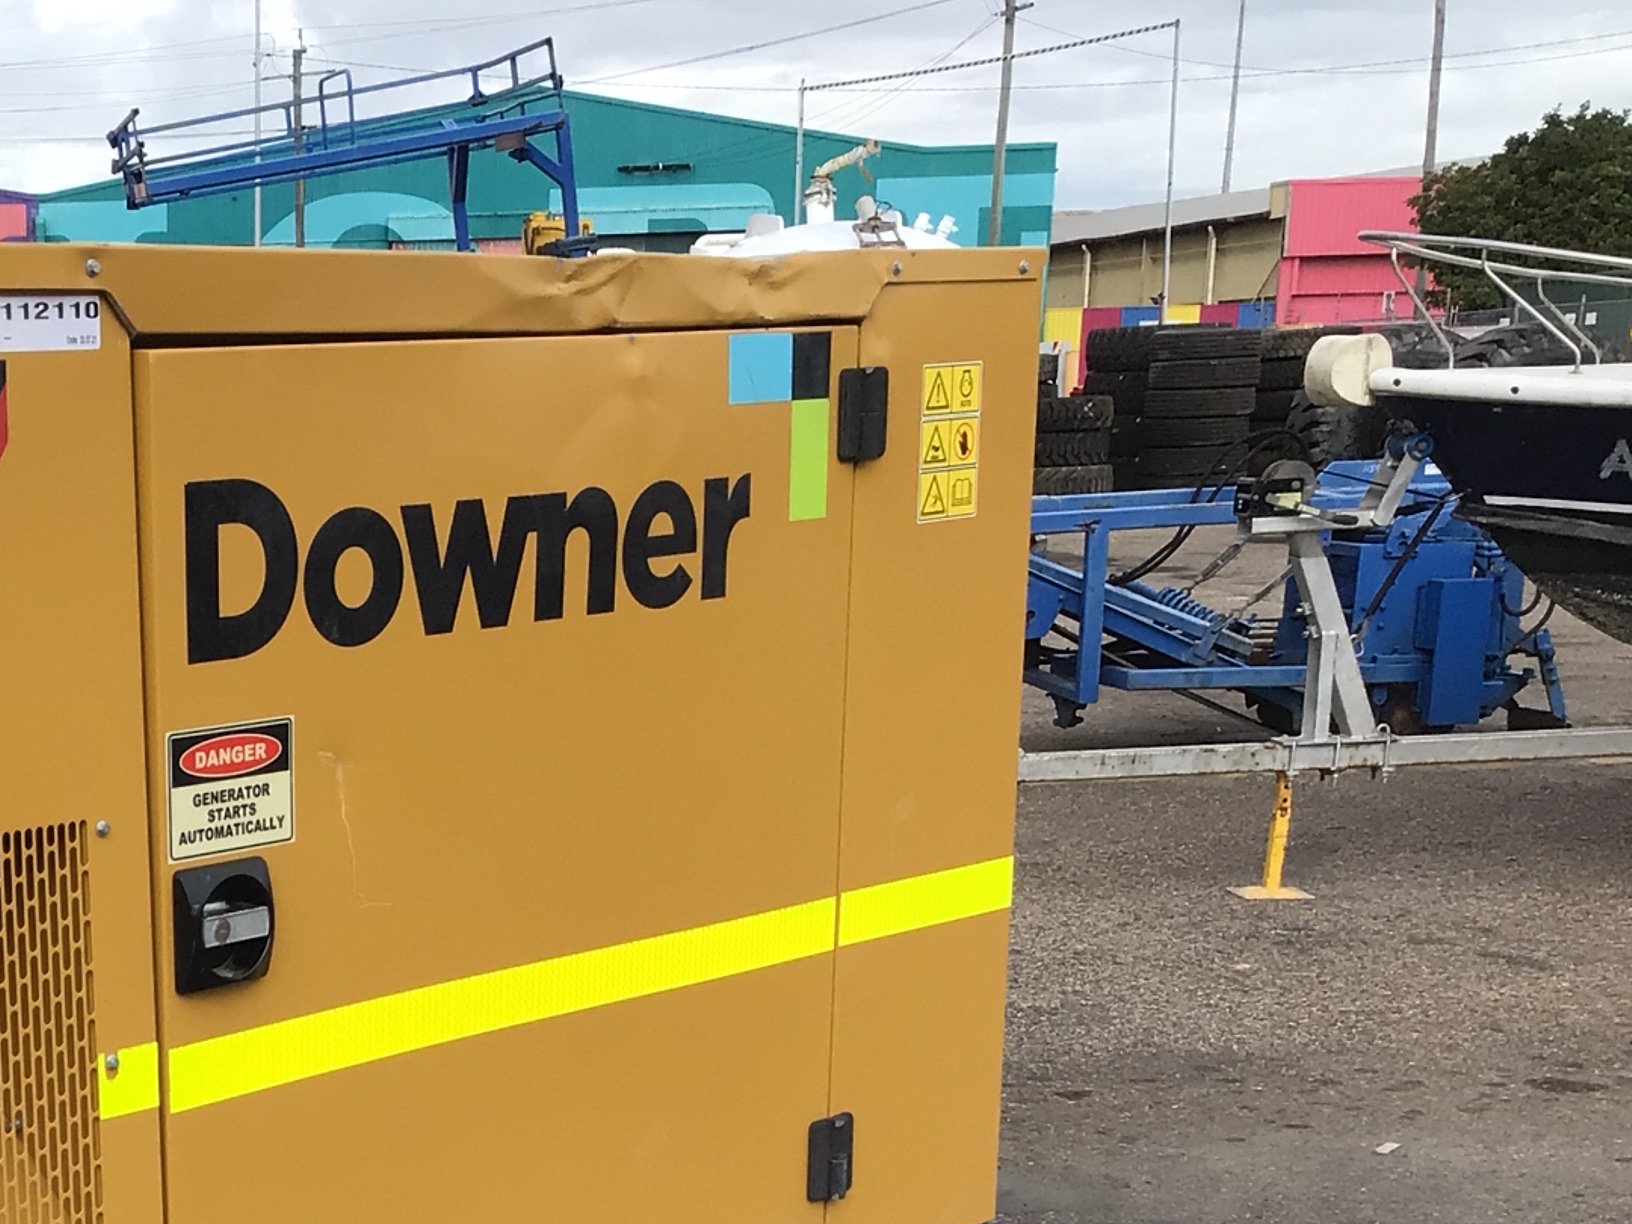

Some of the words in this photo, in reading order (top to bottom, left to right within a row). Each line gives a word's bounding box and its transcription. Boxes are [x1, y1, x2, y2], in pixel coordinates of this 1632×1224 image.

[0, 301, 99, 320] 112110
[184, 472, 751, 666] Downer
[194, 742, 267, 769] DANGER
[192, 783, 270, 807] GENERATOR
[207, 802, 257, 823] STARTS
[178, 815, 285, 846] AUTOMATICALLY
